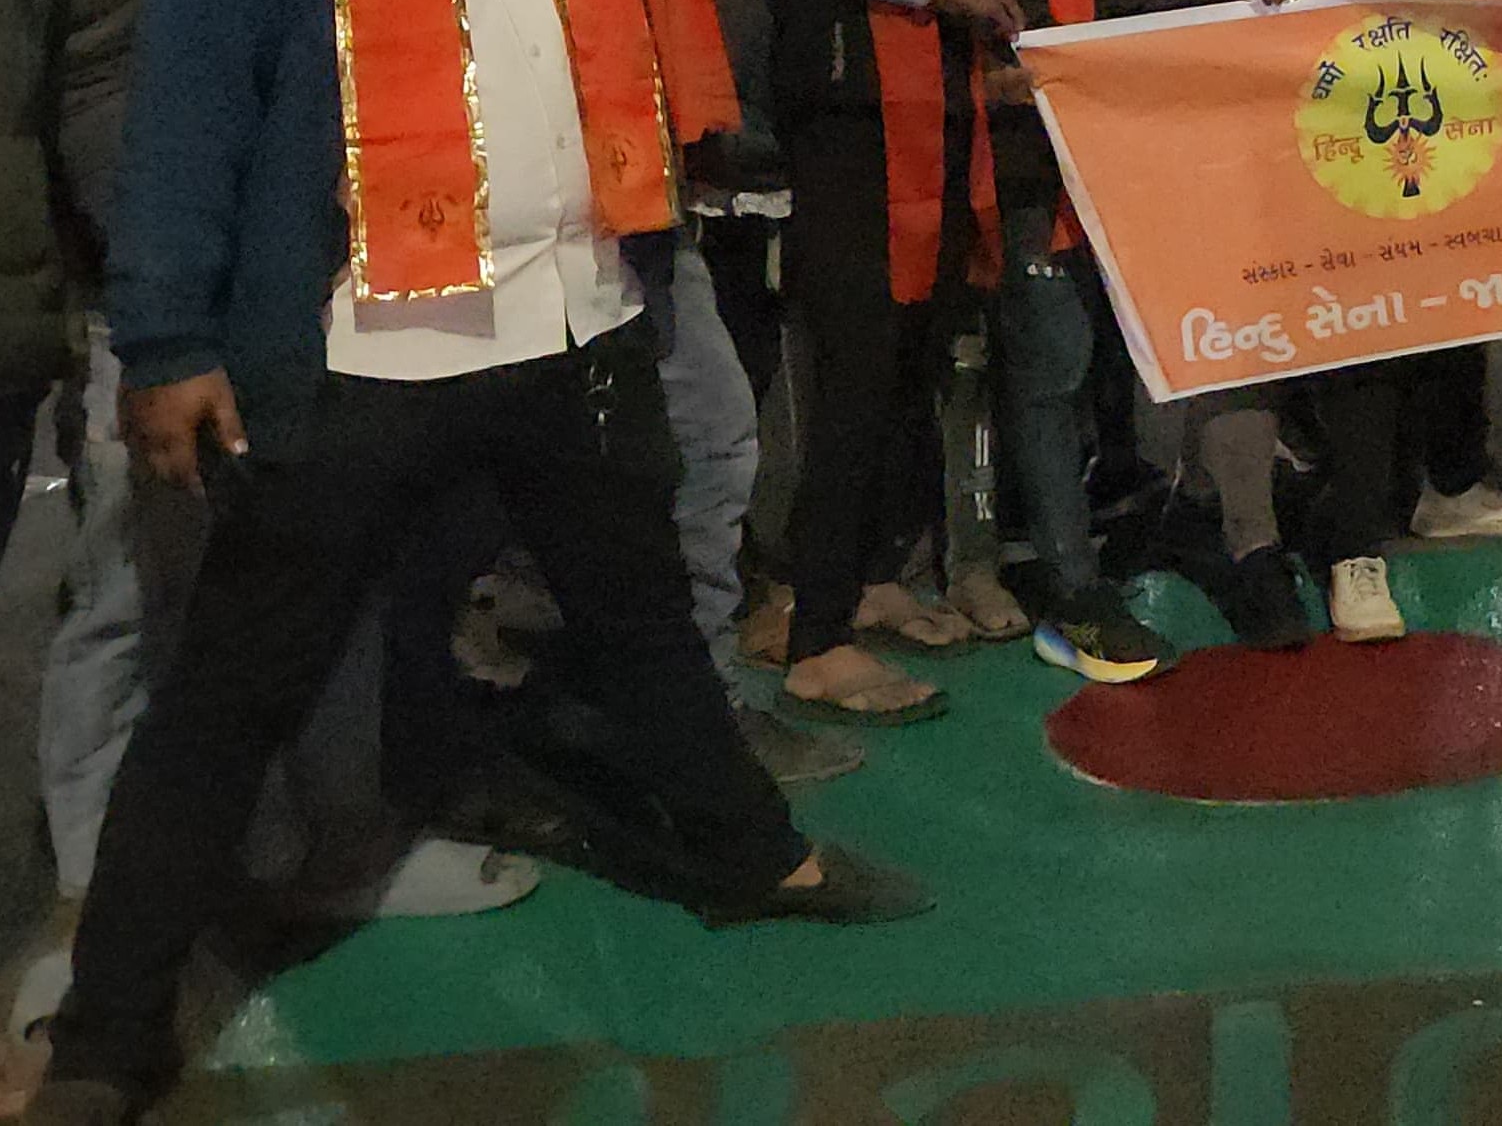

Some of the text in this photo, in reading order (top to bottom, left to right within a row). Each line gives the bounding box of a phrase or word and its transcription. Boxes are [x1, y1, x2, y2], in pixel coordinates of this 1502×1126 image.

[1351, 17, 1413, 51] रक्षति
[1444, 116, 1496, 141] सेना
[1320, 247, 1356, 272] સેવા
[1181, 307, 1296, 362] હિન્દુ
[1305, 286, 1407, 339] સેના
